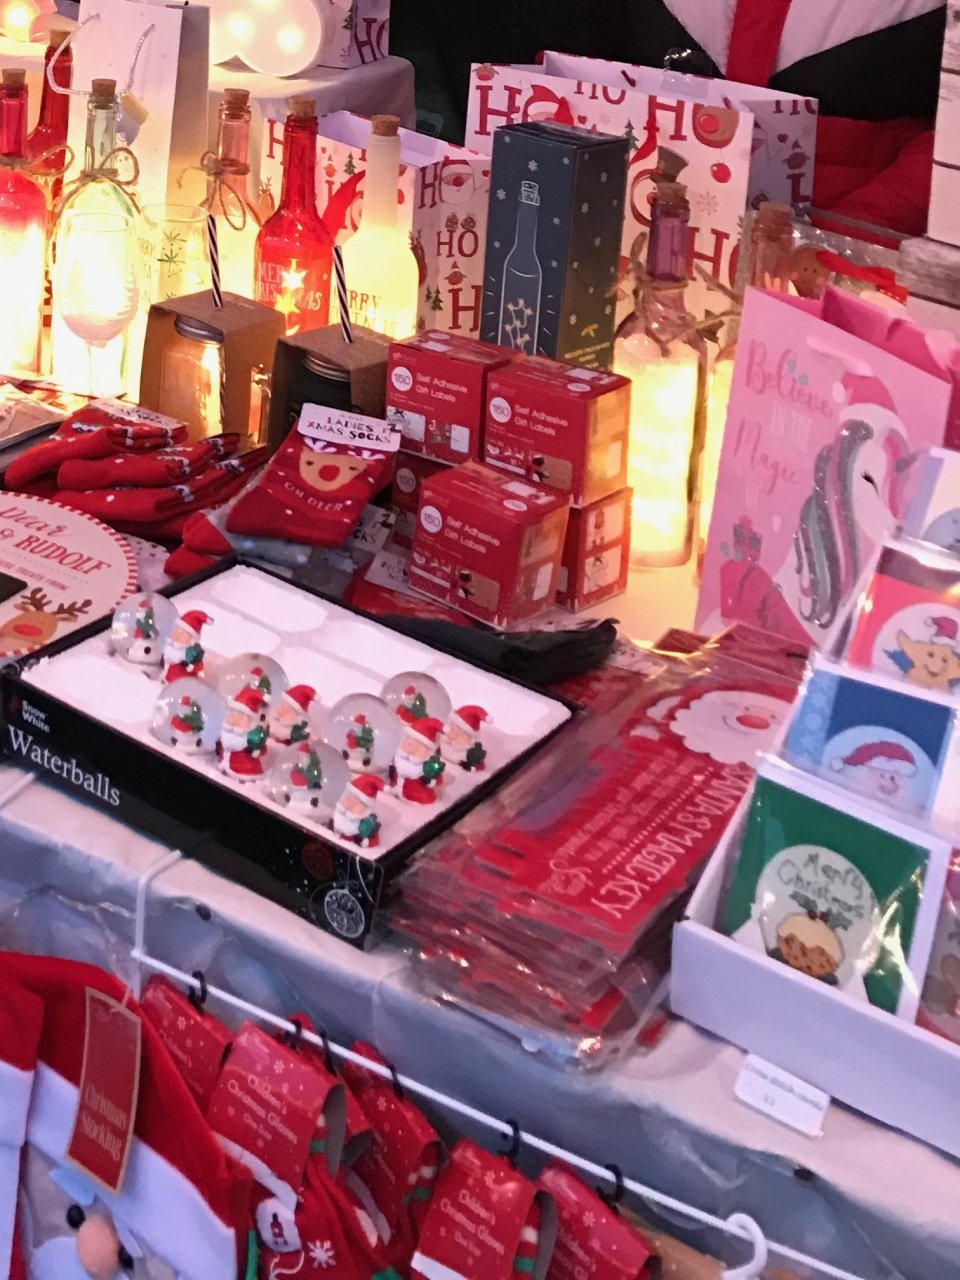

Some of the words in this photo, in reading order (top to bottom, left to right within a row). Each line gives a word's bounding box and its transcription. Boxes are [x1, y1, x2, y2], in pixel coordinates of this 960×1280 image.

[436, 229, 480, 259] HO
[745, 337, 833, 418] Believe
[307, 421, 344, 436] XMAS
[348, 430, 391, 443] SOCKS
[733, 416, 803, 496] Magic
[308, 496, 344, 513] DEER
[15, 534, 113, 575] RUDOLF
[22, 699, 47, 720] Snow
[22, 710, 50, 733] White
[8, 723, 120, 807] Waterballs
[625, 821, 704, 883] MAGIC
[590, 873, 651, 920] KEY
[778, 858, 865, 919] Christmas
[803, 852, 864, 901] Merry
[228, 1079, 266, 1118] Christmas
[267, 1111, 298, 1144] Gloves
